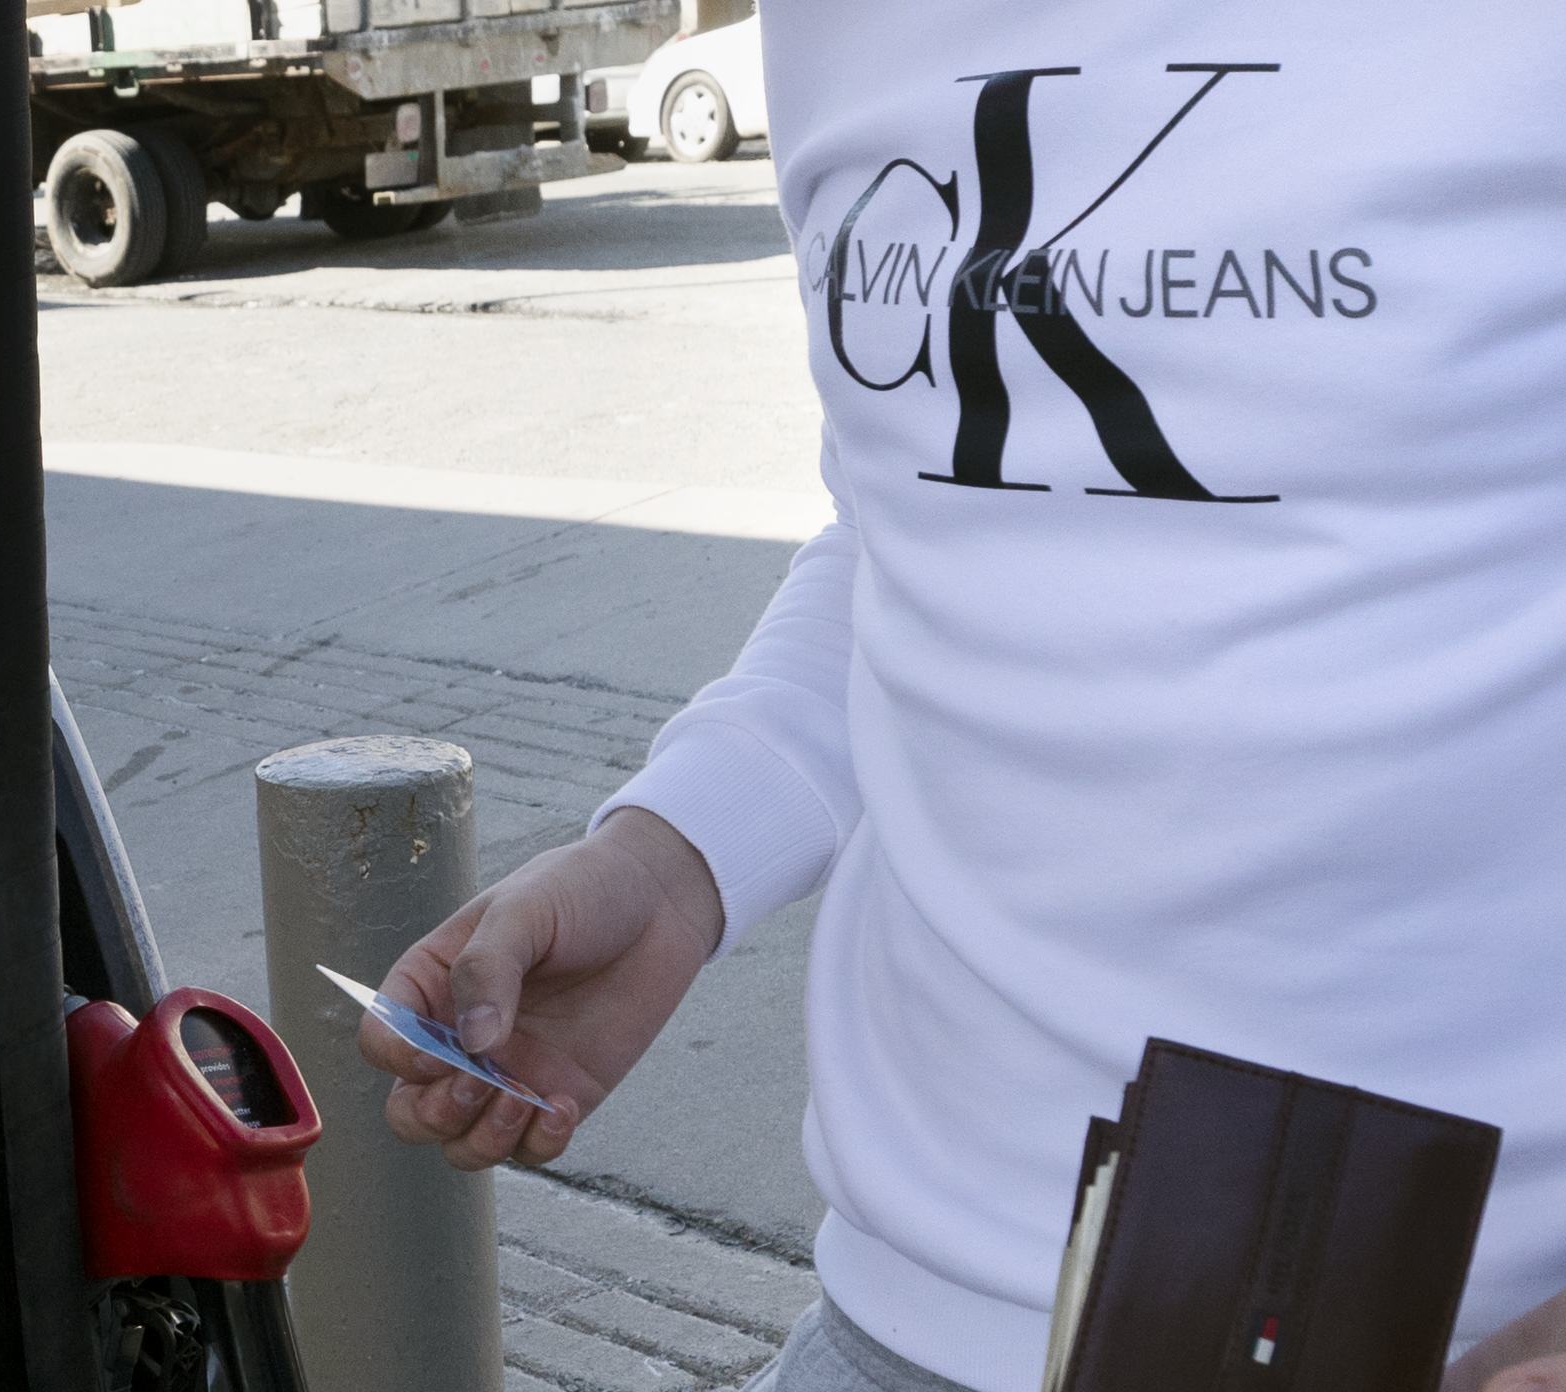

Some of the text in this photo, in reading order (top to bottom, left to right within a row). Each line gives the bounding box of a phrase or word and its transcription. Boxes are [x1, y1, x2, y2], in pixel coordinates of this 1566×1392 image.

[804, 230, 1379, 320] CALVIN KLEIN JEANS
